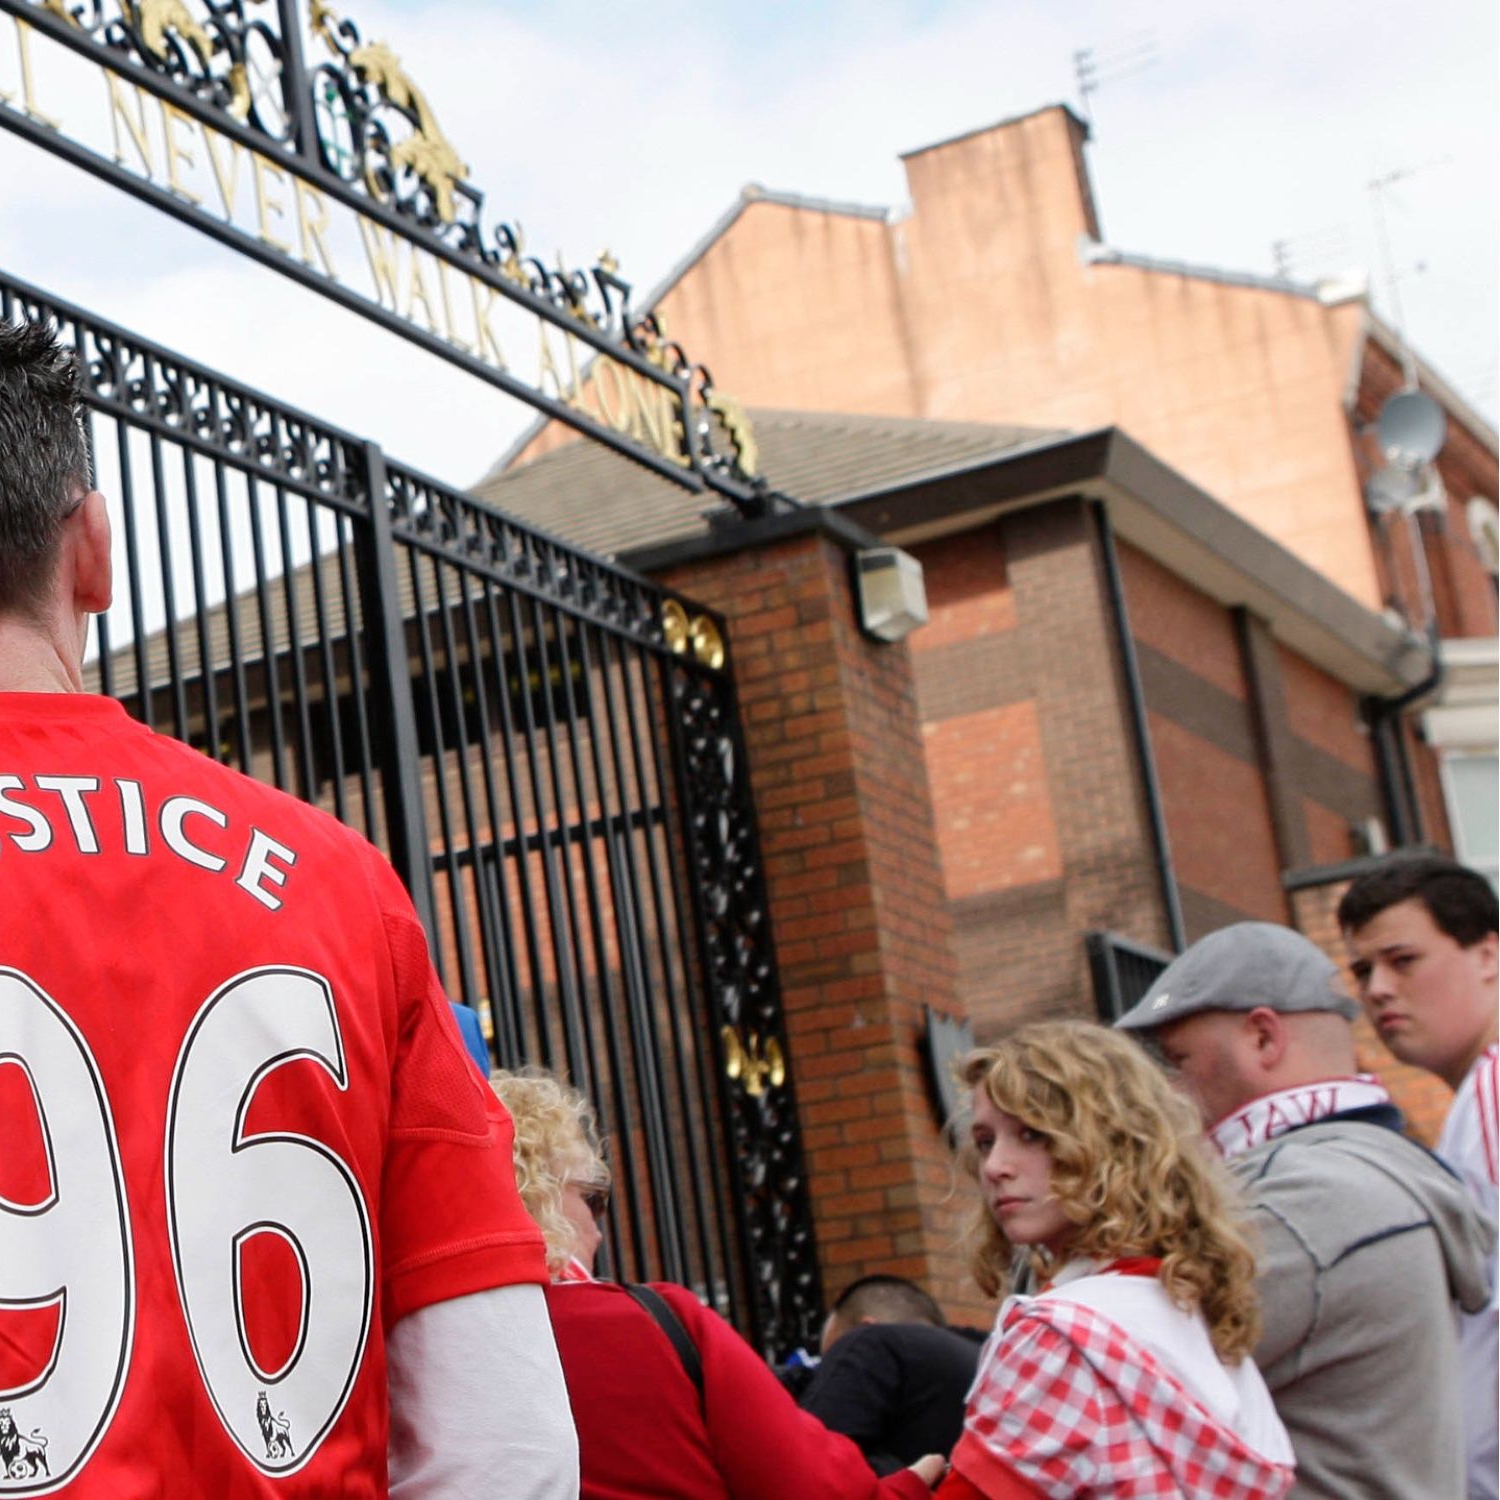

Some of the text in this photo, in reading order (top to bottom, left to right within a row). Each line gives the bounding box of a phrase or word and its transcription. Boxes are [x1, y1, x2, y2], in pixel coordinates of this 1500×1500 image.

[102, 66, 341, 283] NEVER
[355, 213, 511, 374] WALK
[537, 318, 693, 470] ALONE
